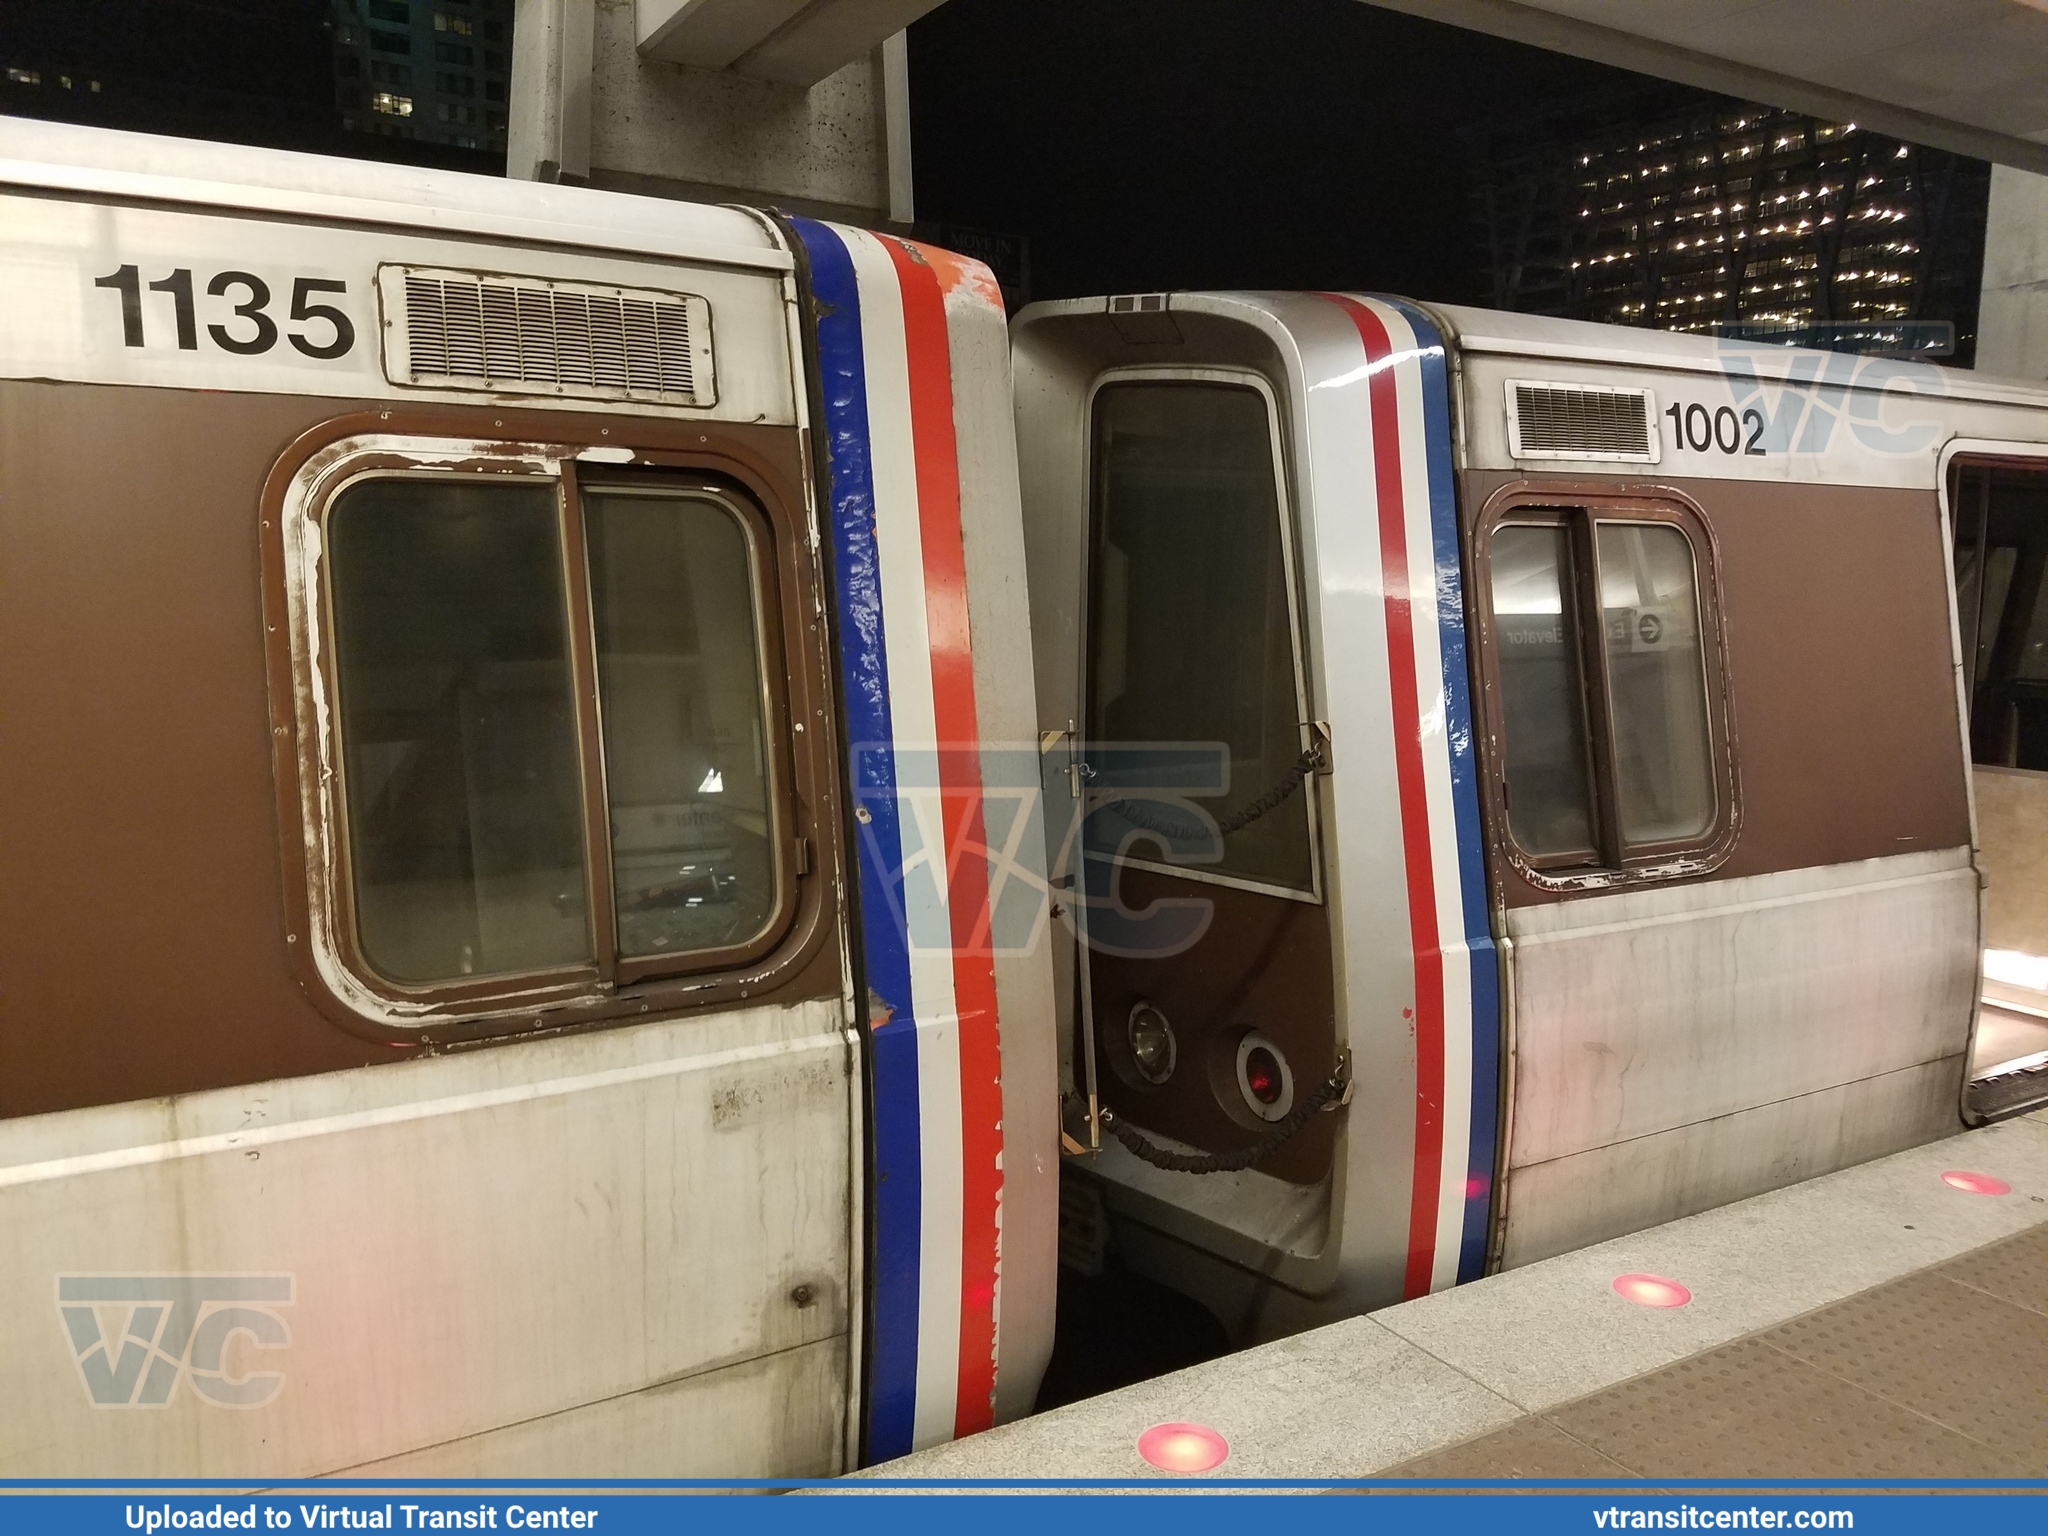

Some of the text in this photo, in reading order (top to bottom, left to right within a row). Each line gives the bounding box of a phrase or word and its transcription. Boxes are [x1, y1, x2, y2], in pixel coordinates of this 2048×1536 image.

[950, 232, 1012, 255] MOVE IN
[95, 265, 355, 360] 1135
[1666, 403, 1766, 456] 1002
